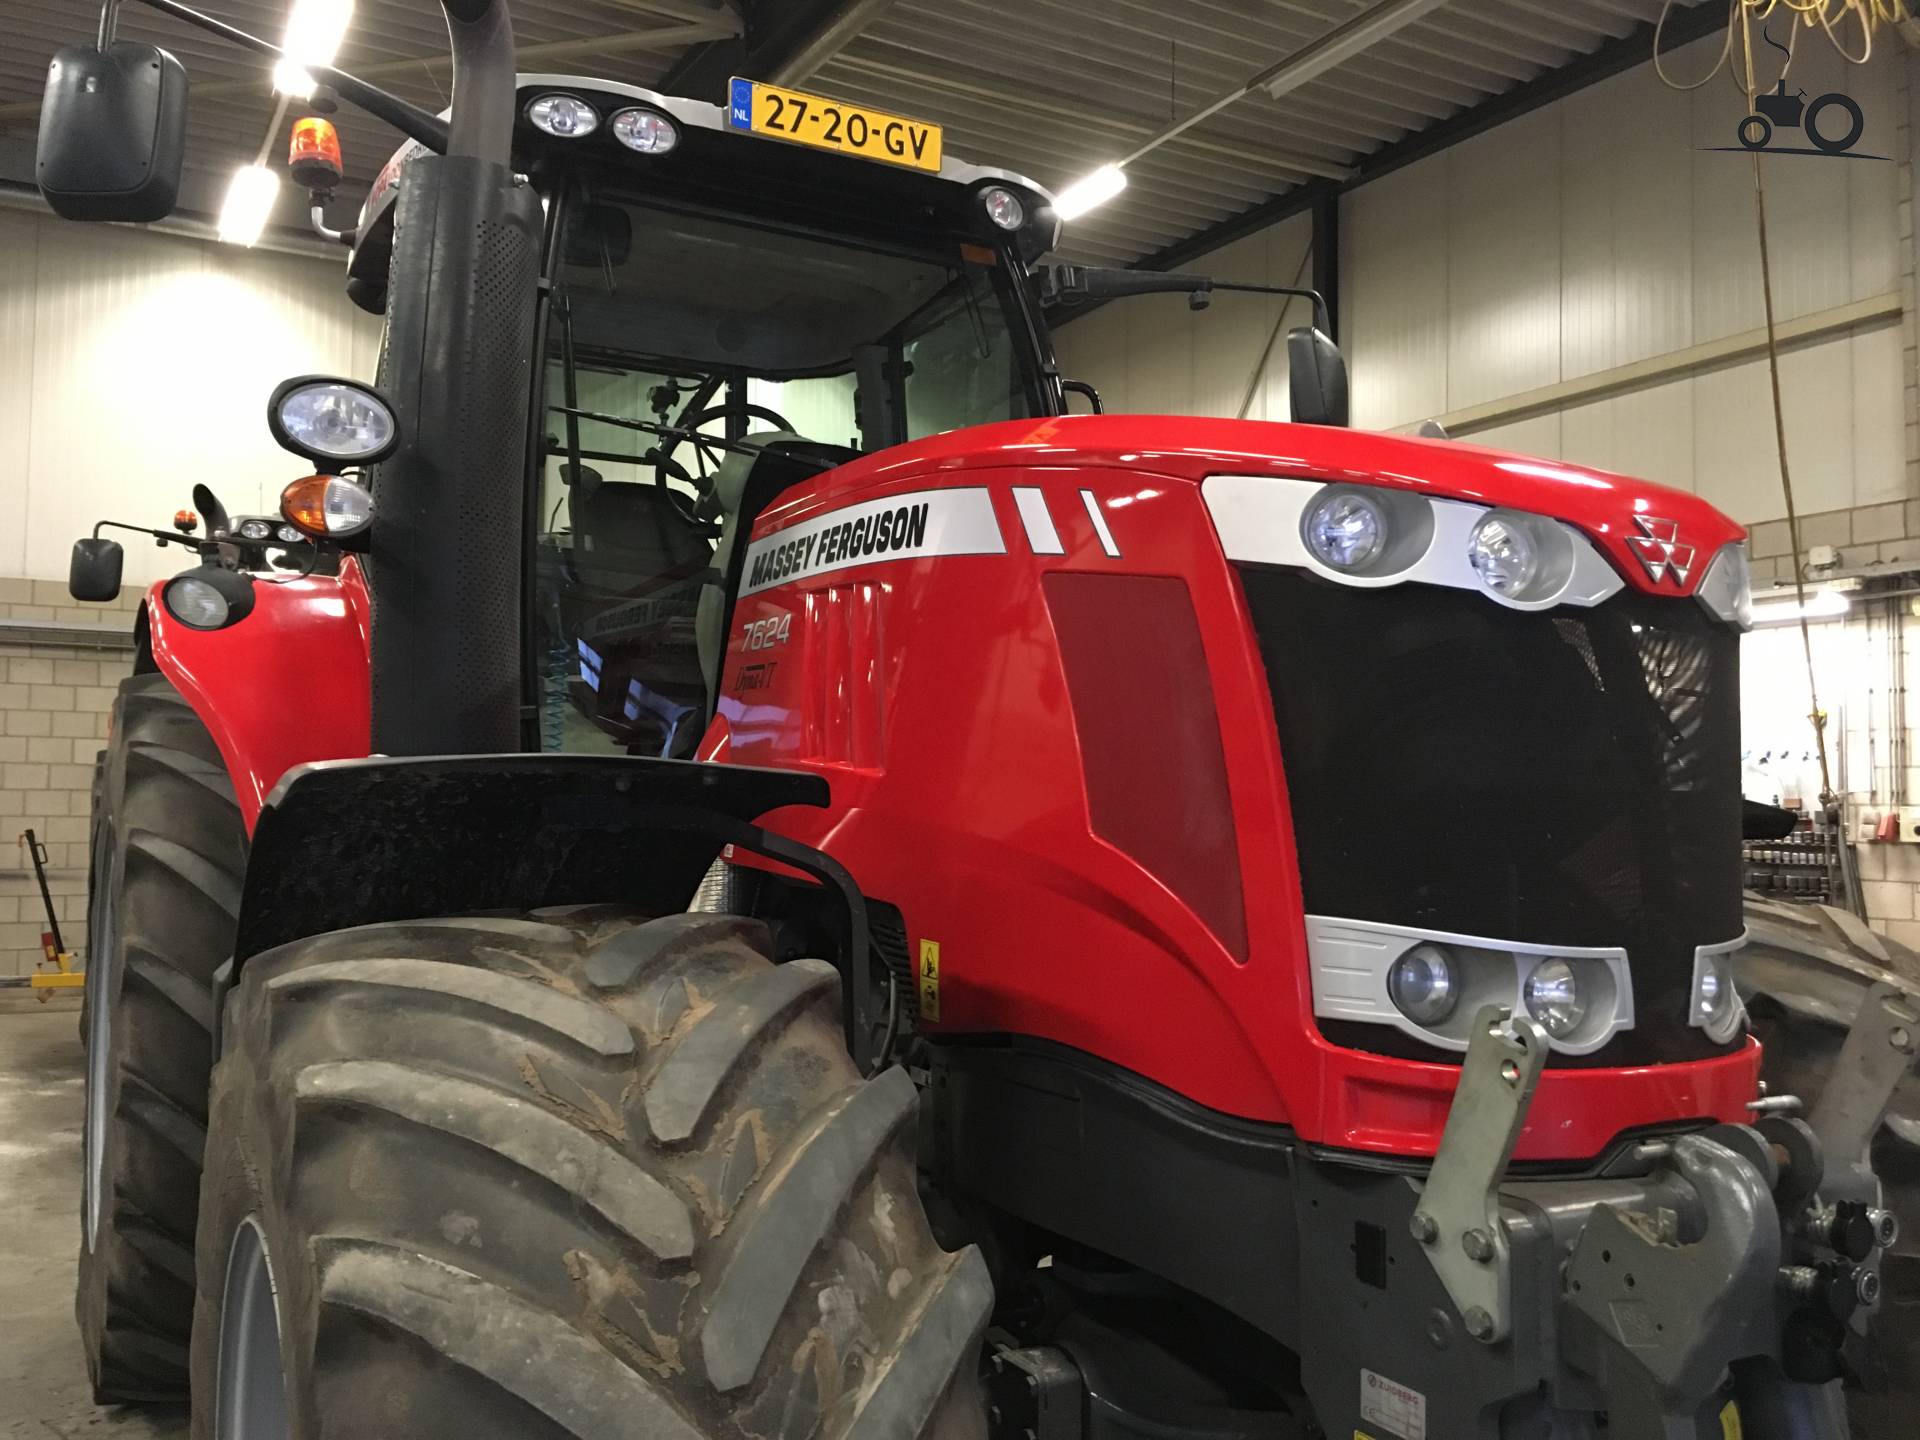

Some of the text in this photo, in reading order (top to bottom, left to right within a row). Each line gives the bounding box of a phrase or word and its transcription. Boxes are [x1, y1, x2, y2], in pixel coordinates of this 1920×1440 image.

[734, 107, 749, 122] NL
[765, 94, 928, 161] 27-20-GV
[748, 502, 929, 588] MASSEY FERGUSON
[740, 612, 792, 653] 7624
